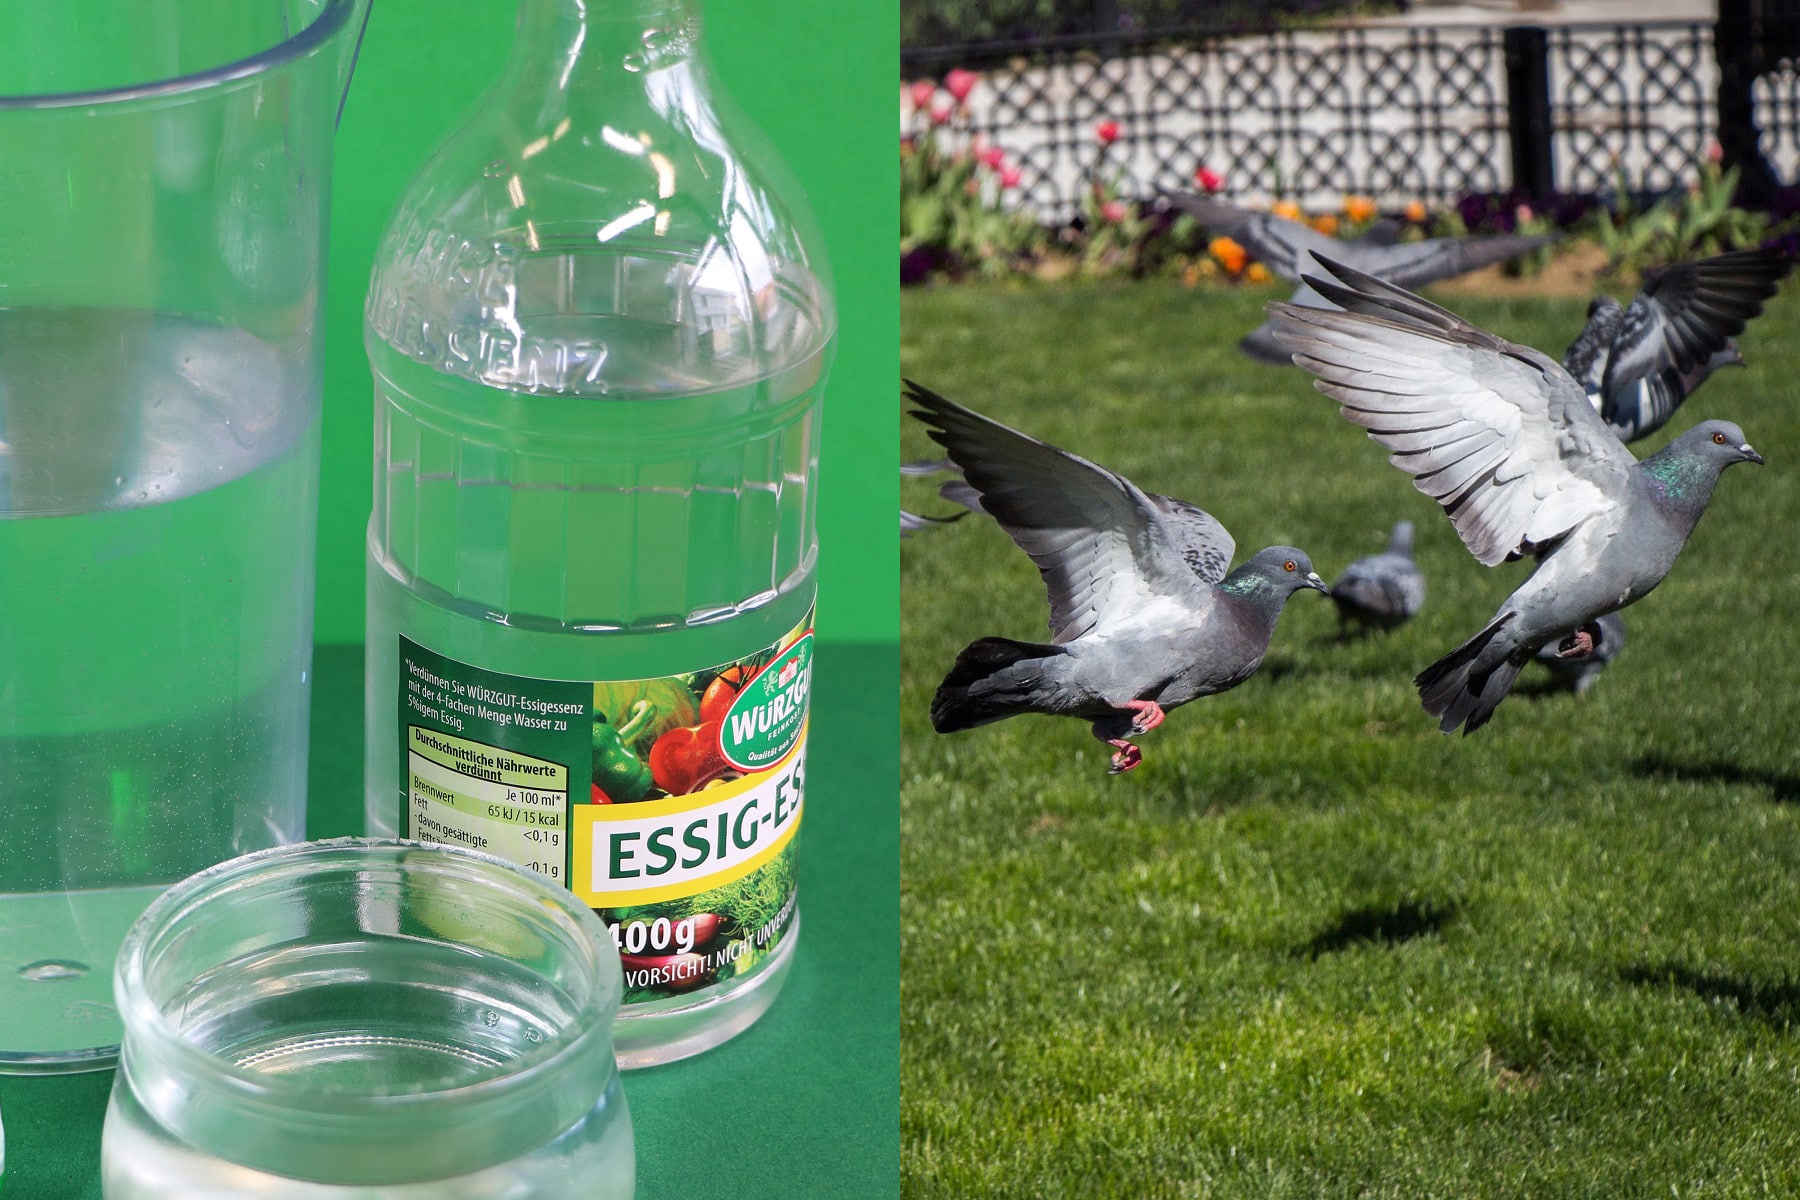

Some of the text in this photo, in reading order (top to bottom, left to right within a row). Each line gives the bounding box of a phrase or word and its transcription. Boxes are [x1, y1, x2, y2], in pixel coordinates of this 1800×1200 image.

[408, 679, 567, 731] mit der 4-fachen Menge Wasser zu
[408, 694, 465, 732] 5%igem Essig.
[452, 680, 465, 695] Sie
[466, 682, 584, 715] WÜRZGUT-Essigessenz
[767, 707, 801, 742] FEINKOST
[415, 728, 556, 777] Durchschnittliche Nährwerte
[748, 747, 778, 761] Qualität
[455, 761, 502, 782] verdünnt
[414, 775, 455, 805] Brennwert
[505, 788, 517, 801] Je
[519, 791, 539, 805] 100
[414, 795, 559, 846] Fett <0,1 g
[418, 812, 441, 833] davon
[443, 827, 488, 848] gesättigte
[488, 805, 559, 826] 65 kJ / 15 kcal
[608, 758, 803, 879] ESSIG-ES
[551, 866, 558, 878] g
[626, 953, 711, 988] VORSICHT!
[716, 934, 754, 968] NICHT
